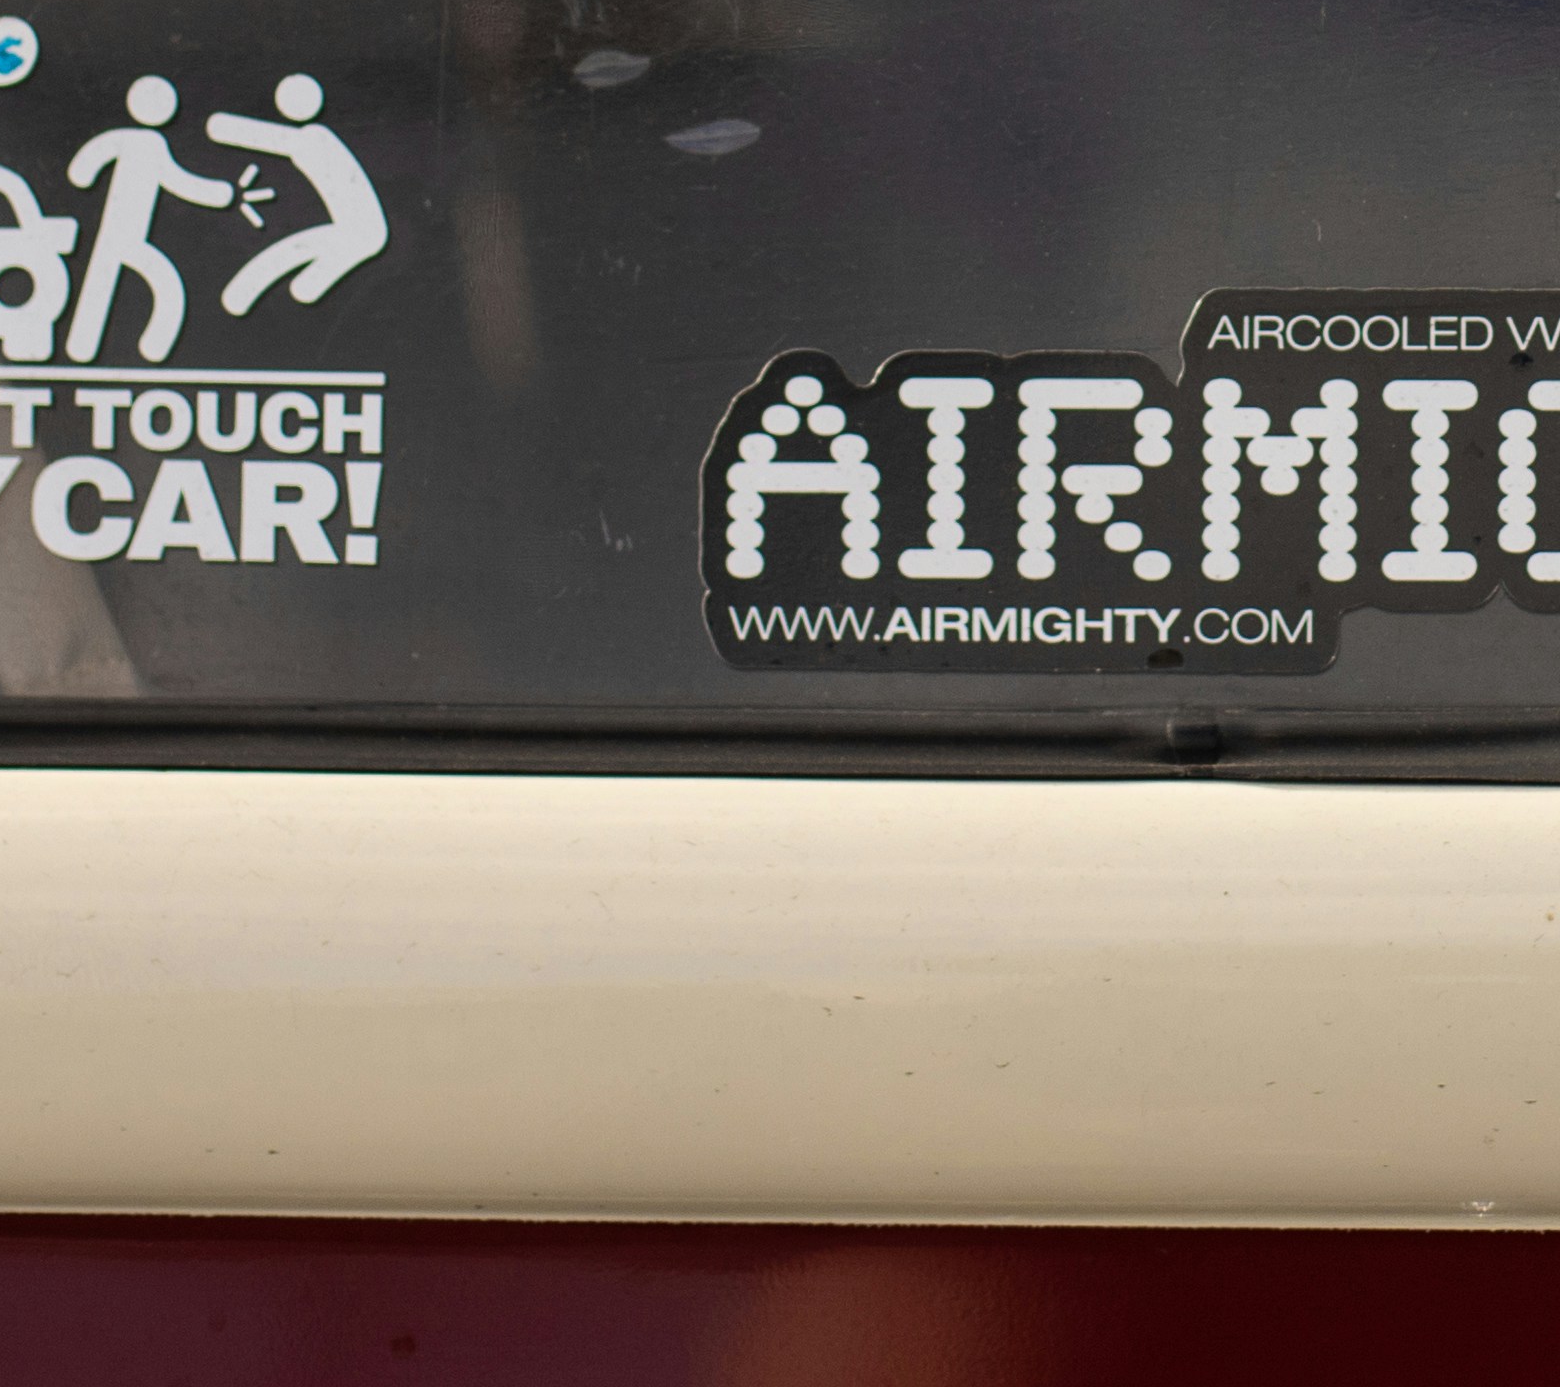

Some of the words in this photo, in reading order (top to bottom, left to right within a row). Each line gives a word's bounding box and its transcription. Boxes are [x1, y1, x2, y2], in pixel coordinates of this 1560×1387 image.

[1207, 314, 1494, 352] AIRCOOLED
[74, 388, 386, 454] TOUCH
[30, 456, 383, 566] CAR!
[728, 606, 1314, 645] WWW.AIRMIGHTY.COM
